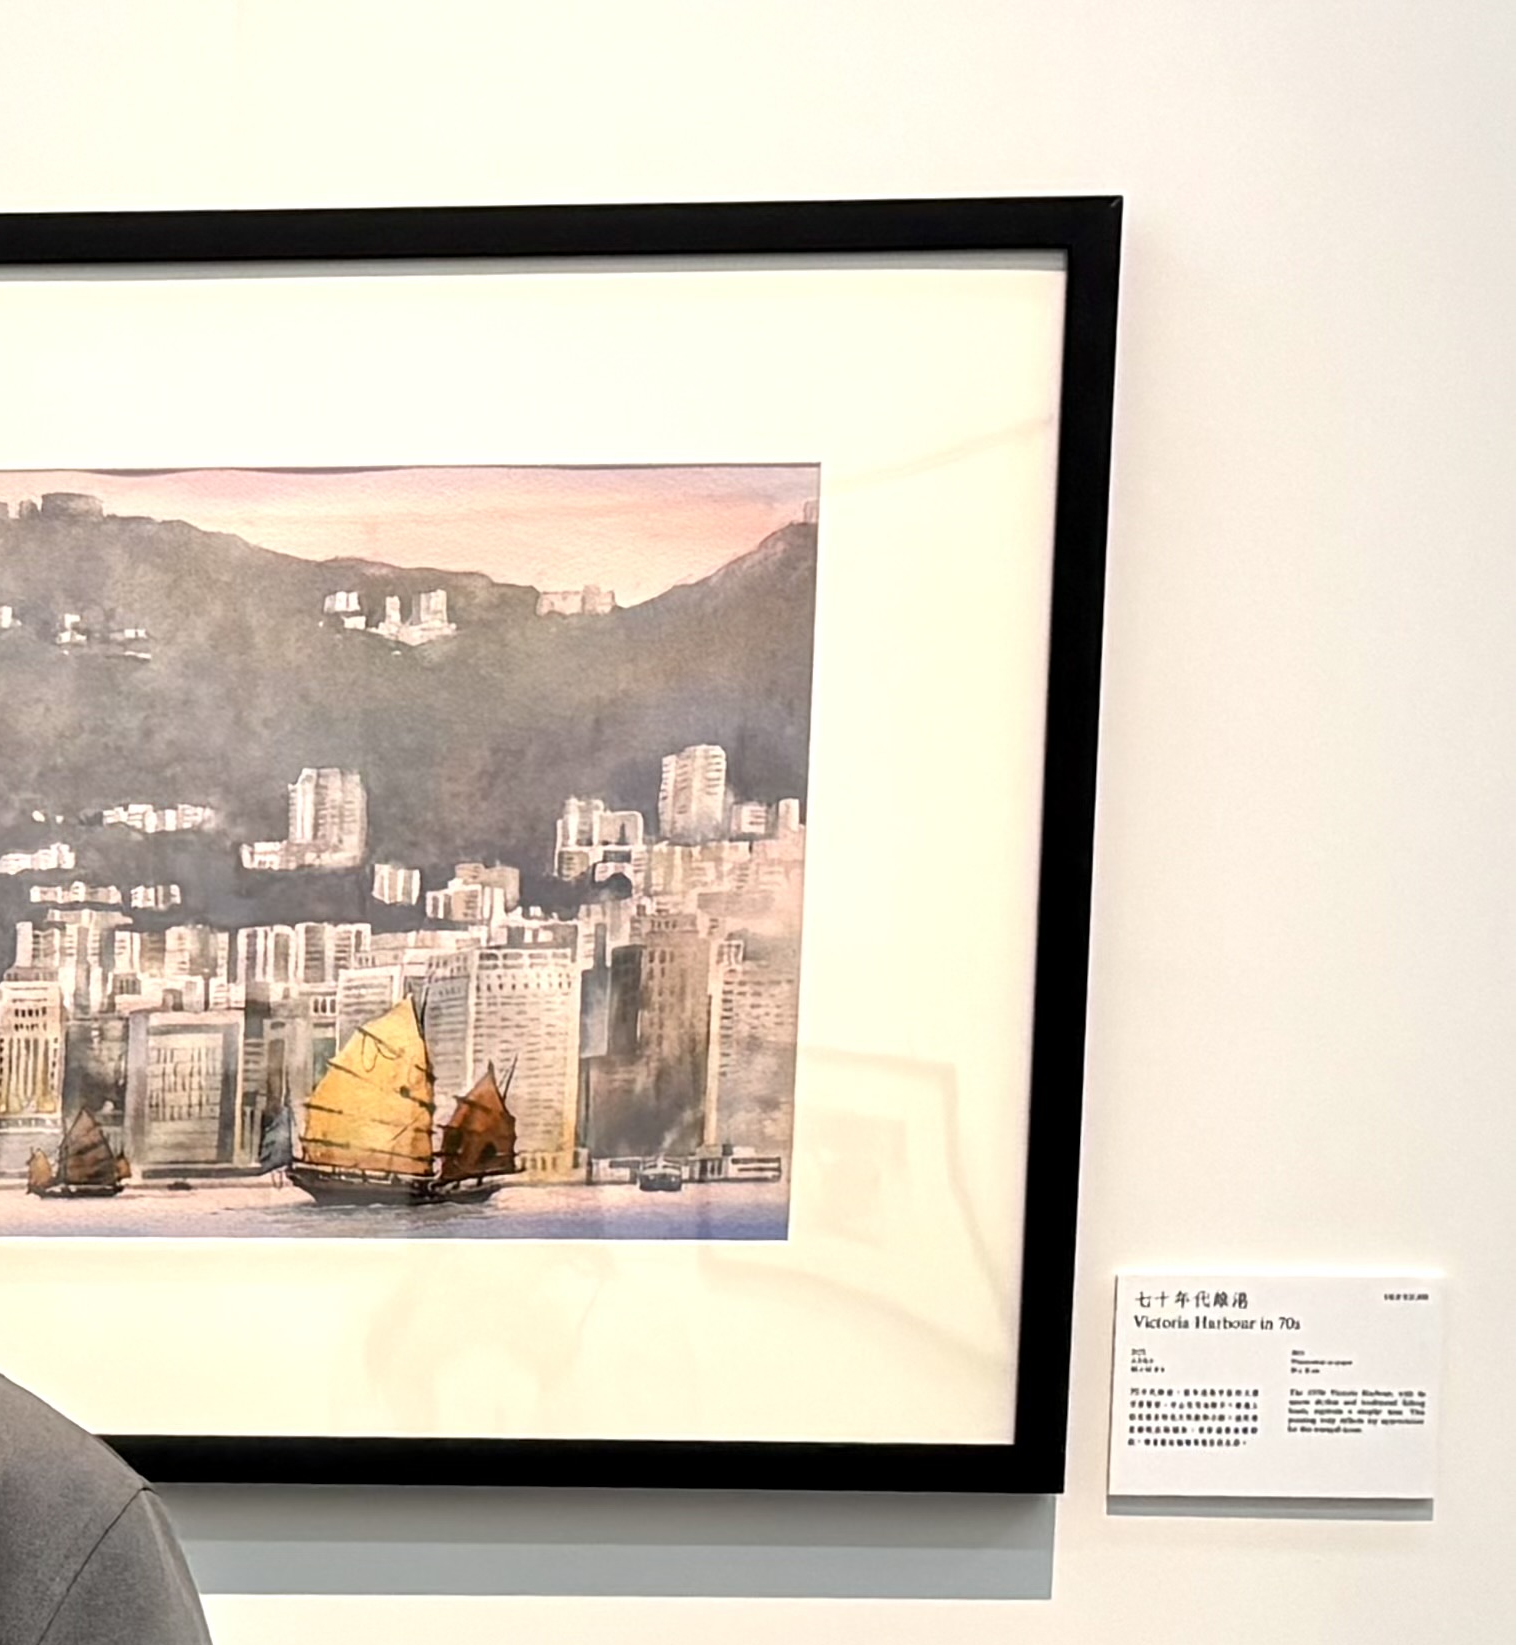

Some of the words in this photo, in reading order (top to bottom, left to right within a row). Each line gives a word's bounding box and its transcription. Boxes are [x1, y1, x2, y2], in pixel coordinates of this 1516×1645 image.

[1134, 1314, 1189, 1330] Victoria
[1195, 1315, 1255, 1330] Harbour
[1260, 1317, 1273, 1330] in
[1278, 1316, 1301, 1331] 70s
